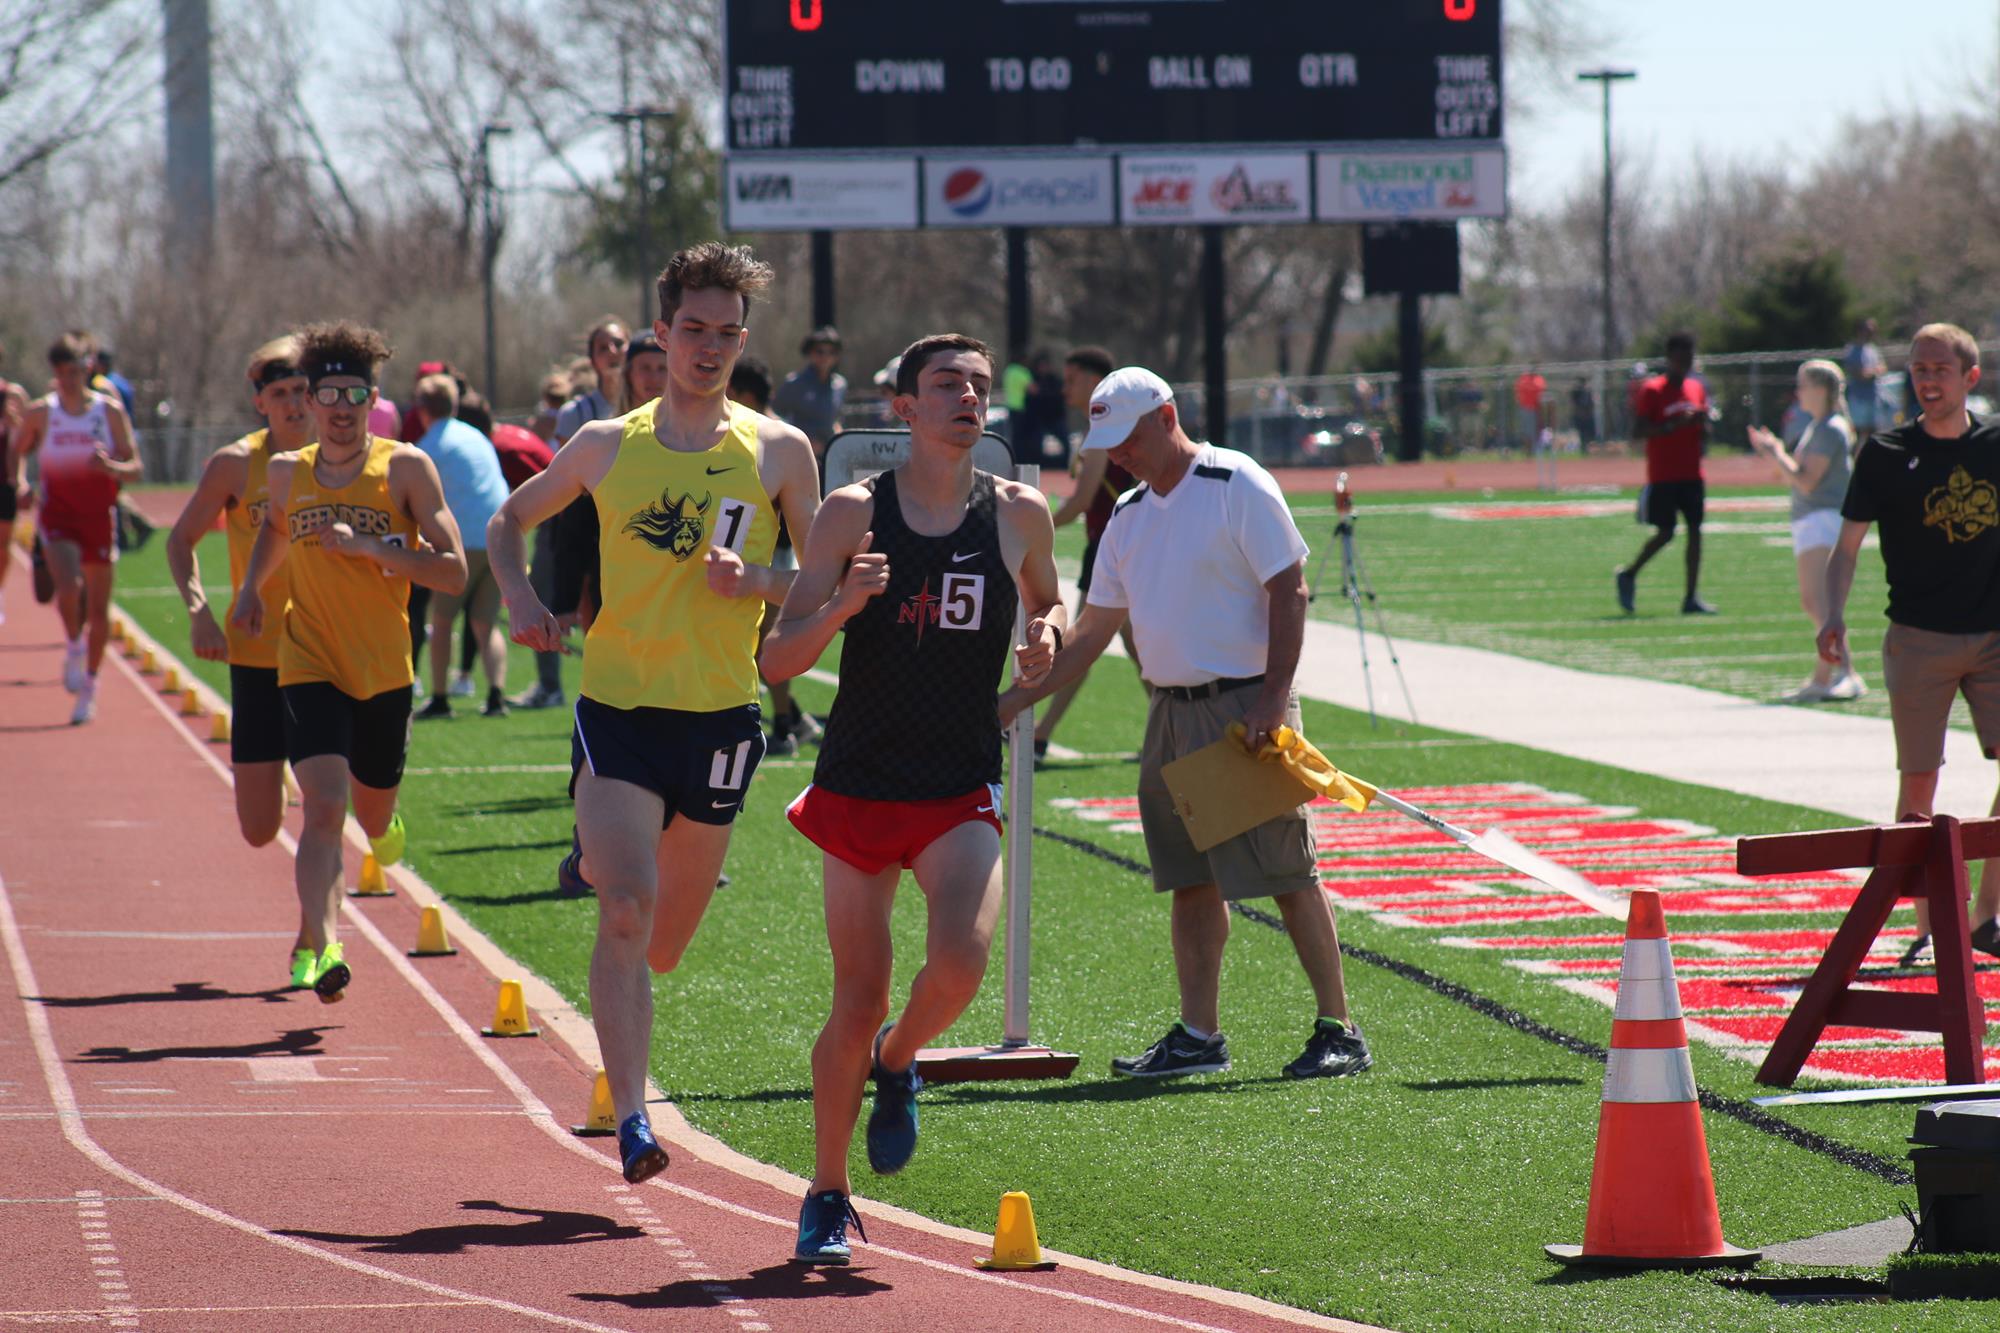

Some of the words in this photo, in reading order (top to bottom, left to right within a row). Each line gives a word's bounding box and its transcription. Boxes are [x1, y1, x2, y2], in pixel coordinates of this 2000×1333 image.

[737, 66, 792, 91] TIME
[856, 59, 945, 91] DOWN
[987, 58, 1023, 91] TO
[1029, 58, 1071, 90] GO
[1149, 56, 1209, 88] BALL
[1214, 54, 1251, 87] ON
[1300, 53, 1357, 87] QTR
[1434, 55, 1491, 81] TIME
[731, 93, 794, 119] OUTS
[1435, 83, 1497, 111] OUTS
[736, 121, 790, 146] LEFT
[1435, 112, 1489, 136] LEFT
[1341, 156, 1472, 184] Diamond
[998, 171, 1099, 209] pepsi
[1357, 179, 1435, 214] Vogel
[288, 503, 392, 543] DEFENDERS
[724, 504, 745, 548] 1
[945, 577, 976, 626] 5
